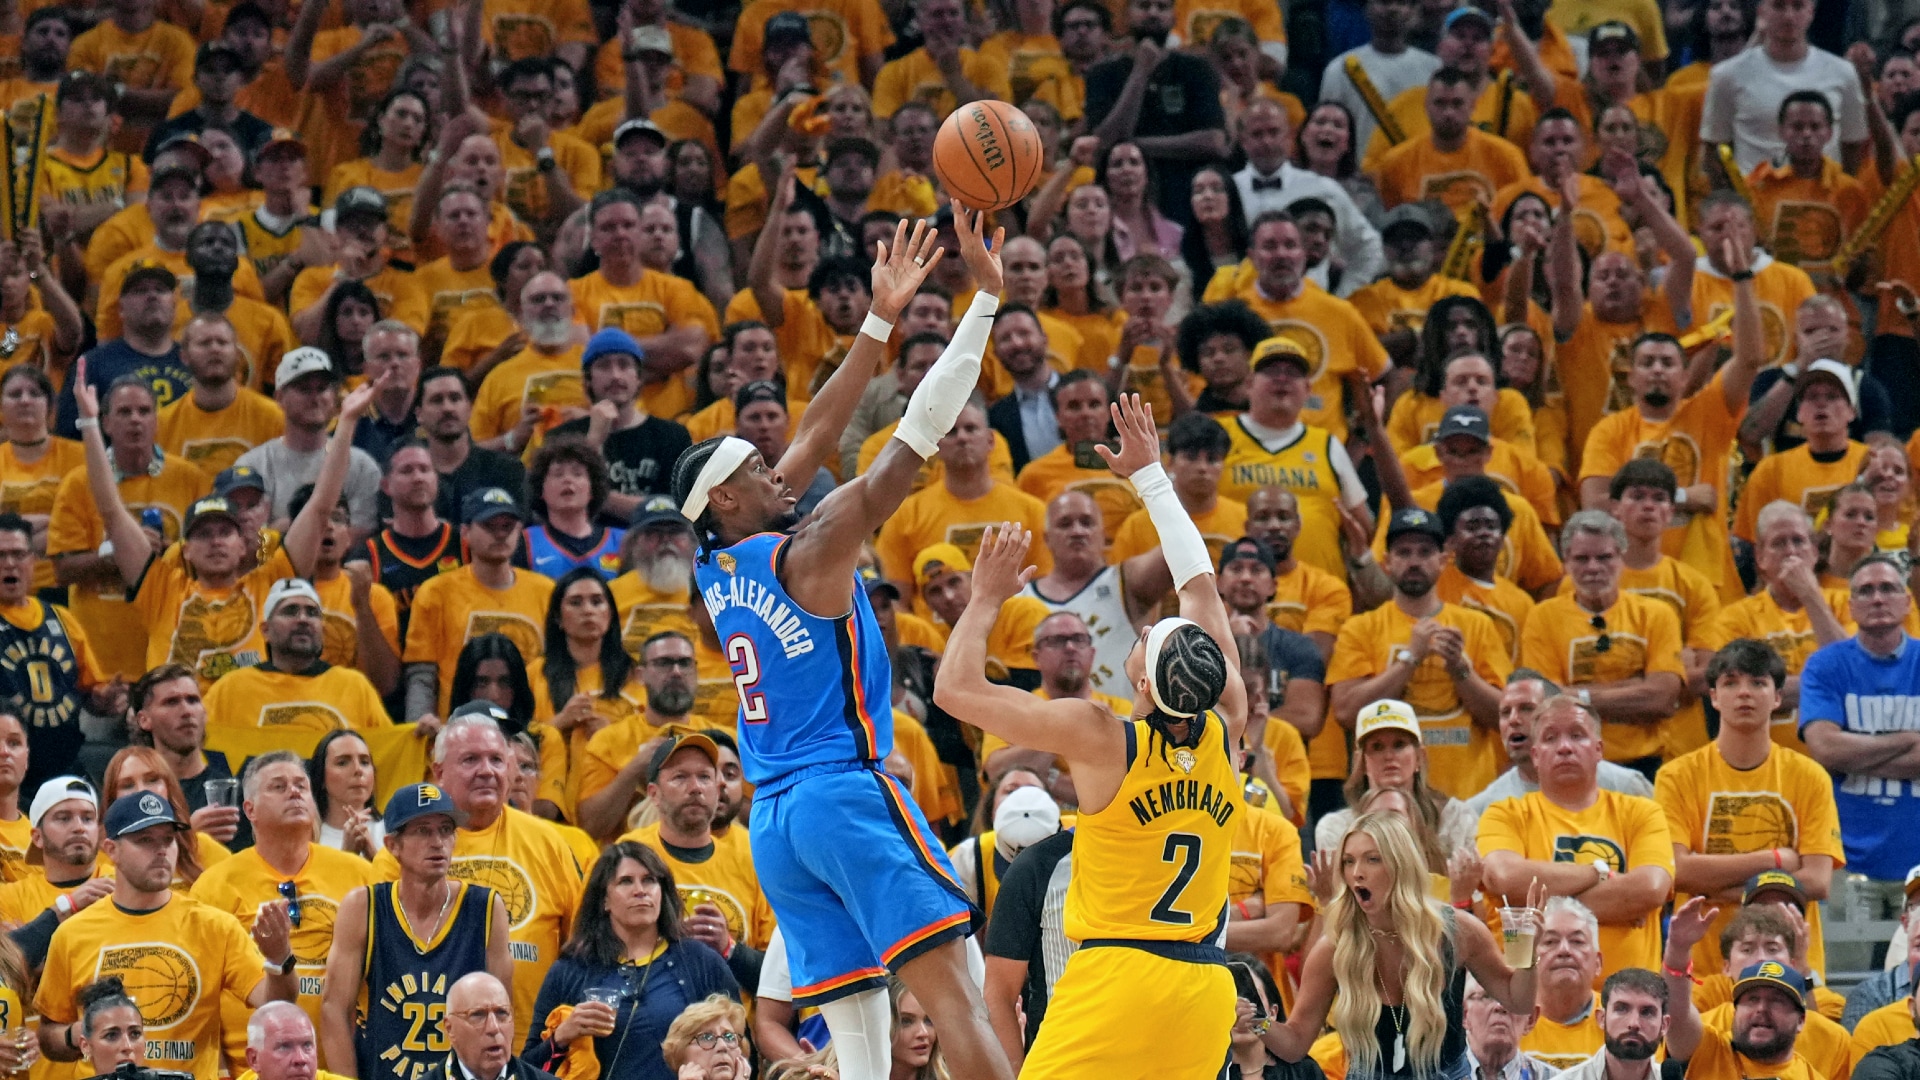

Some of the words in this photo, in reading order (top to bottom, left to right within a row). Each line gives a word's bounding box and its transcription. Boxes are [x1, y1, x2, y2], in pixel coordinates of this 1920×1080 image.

[1232, 463, 1319, 489] INDIANA
[703, 576, 814, 660] US-ALEXANDER
[0, 637, 73, 673] INDIANA
[27, 661, 52, 703] 0
[726, 632, 769, 724] 2
[1129, 779, 1234, 828] NEMBHARD
[1149, 831, 1203, 925] 2
[300, 977, 321, 995] 025
[380, 971, 446, 1013] INDIA
[402, 1002, 452, 1052] 23
[164, 1041, 195, 1060] FINALS
